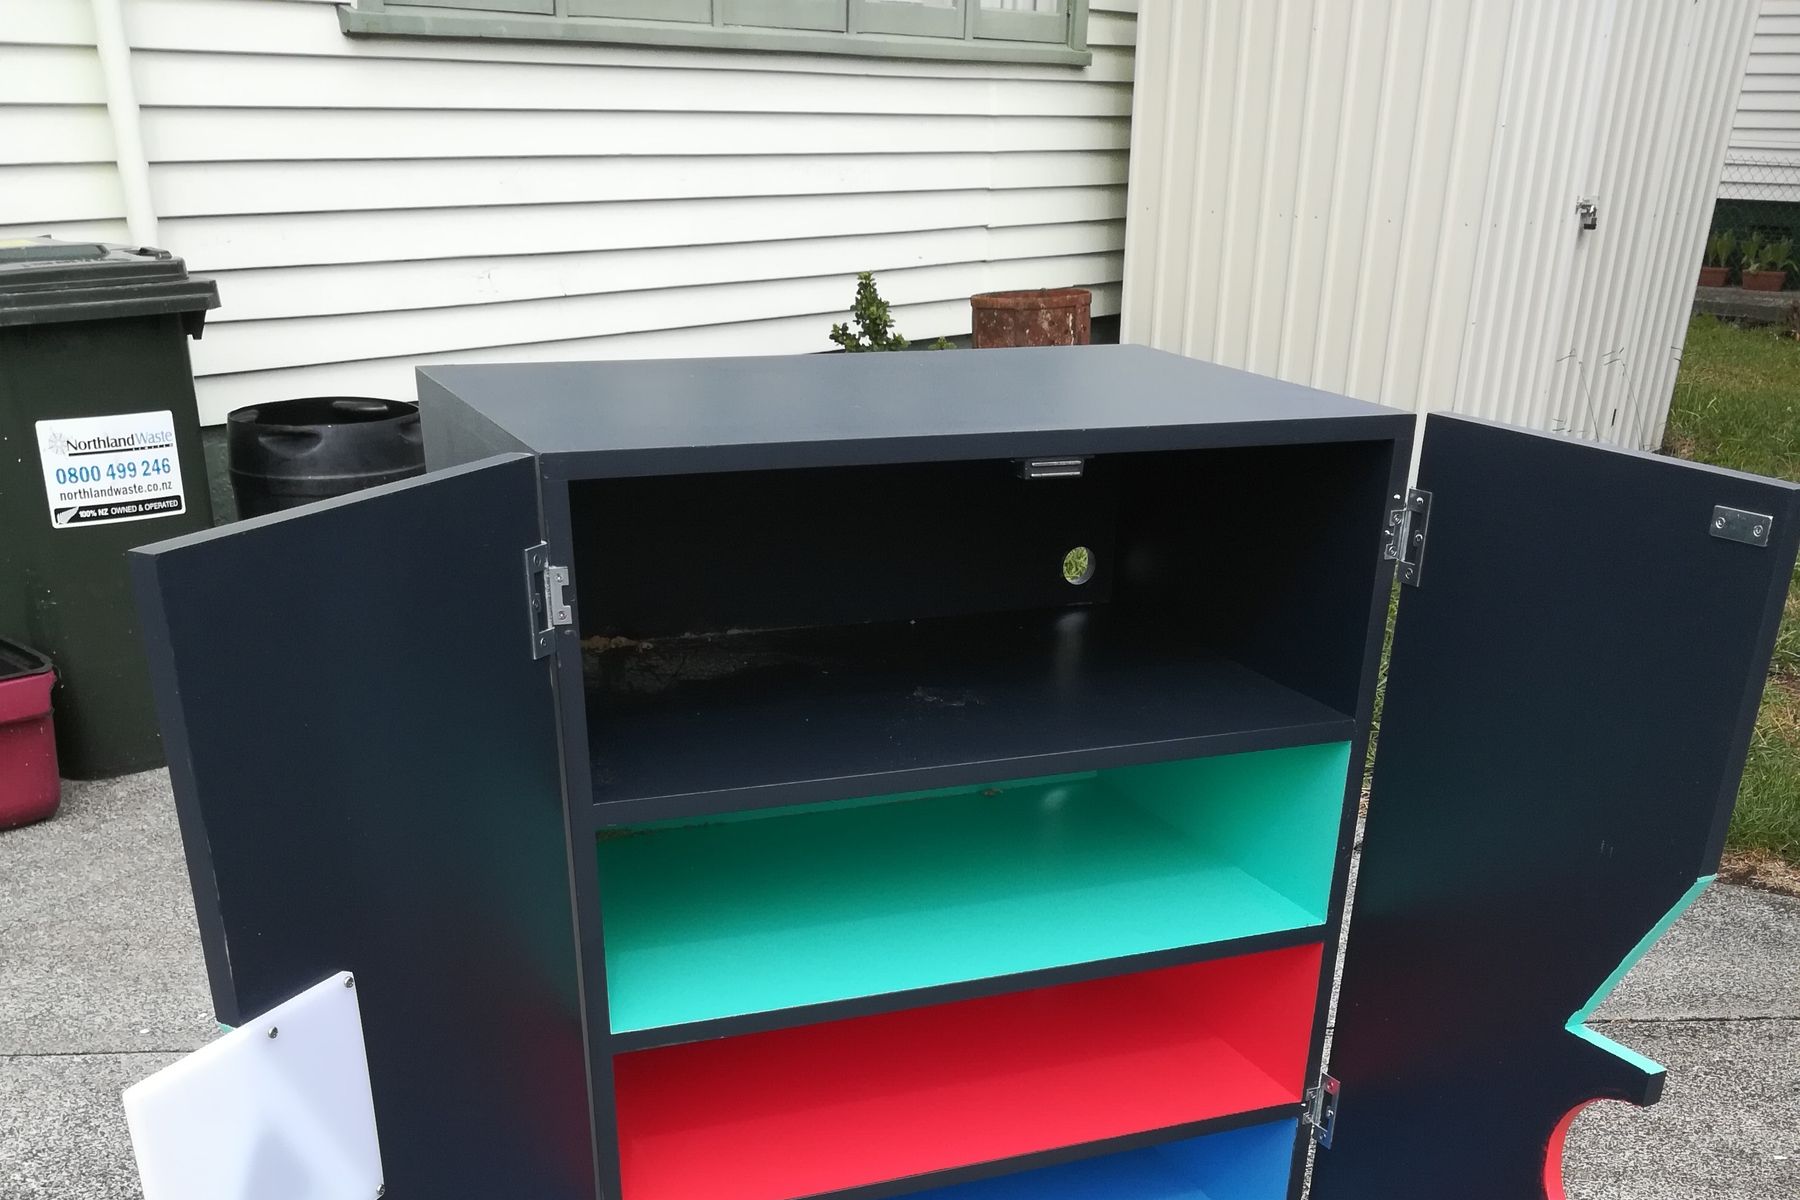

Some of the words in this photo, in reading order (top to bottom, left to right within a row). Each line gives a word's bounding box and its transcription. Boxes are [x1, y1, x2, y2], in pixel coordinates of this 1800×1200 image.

[56, 465, 101, 485] 0800
[106, 461, 137, 481] 499
[141, 457, 171, 477] 246
[59, 480, 173, 501] northlandwaste.co.nz
[78, 509, 97, 518] 100%
[98, 508, 109, 516] NZ
[110, 505, 137, 515] OWNED
[138, 503, 143, 512] &
[144, 499, 179, 511] OPERATED
